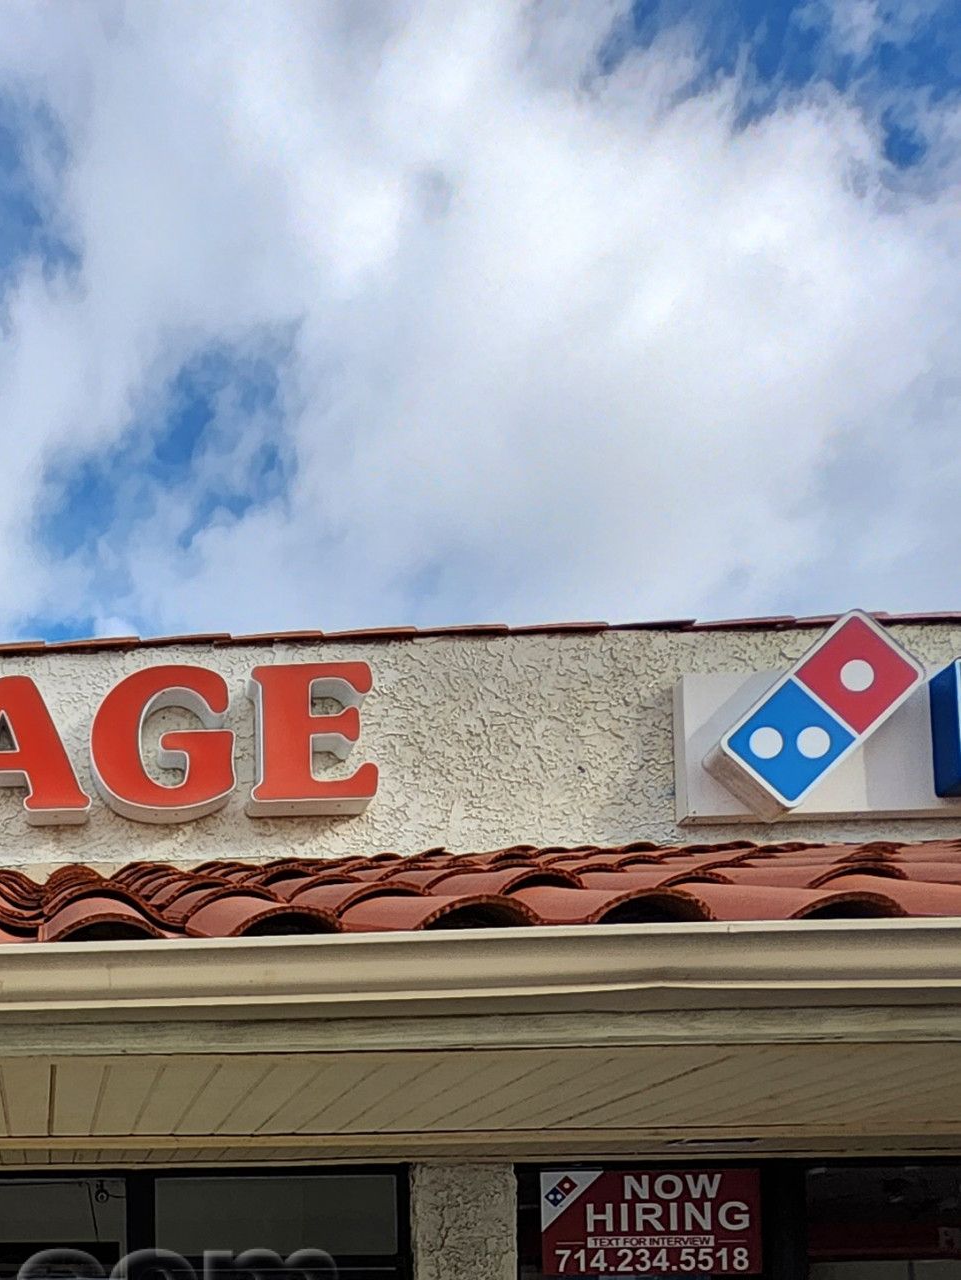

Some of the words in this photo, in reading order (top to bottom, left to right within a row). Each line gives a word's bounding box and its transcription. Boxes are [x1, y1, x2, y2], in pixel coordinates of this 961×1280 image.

[623, 1173, 722, 1200] NOW
[586, 1201, 750, 1233] HIRING
[592, 1237, 621, 1247] TEXT
[623, 1237, 646, 1247] FOR
[649, 1236, 711, 1246] INTERVIEW
[555, 1248, 749, 1273] 714.234.5518
